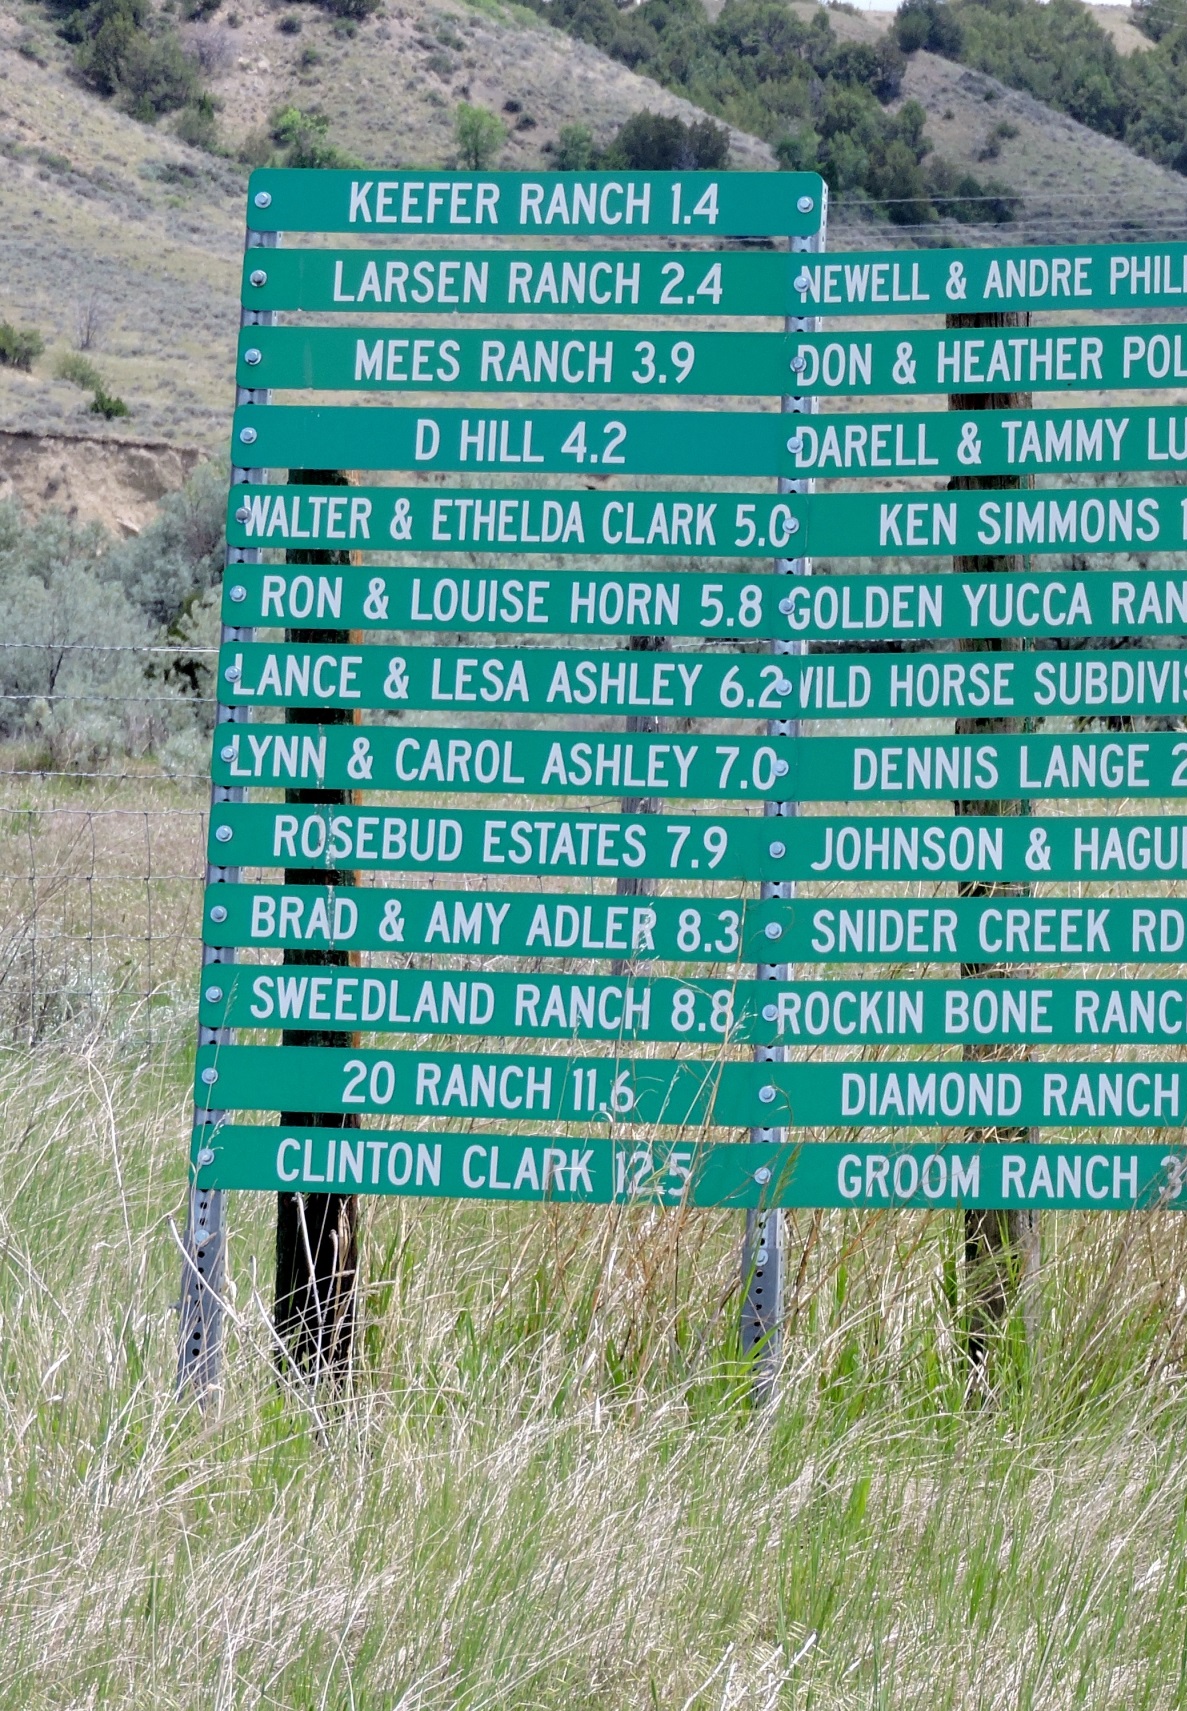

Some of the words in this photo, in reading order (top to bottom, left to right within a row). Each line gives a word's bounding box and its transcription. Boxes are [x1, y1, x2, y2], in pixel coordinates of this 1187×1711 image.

[350, 182, 499, 223] KEEFER
[520, 183, 650, 224] RANCH
[672, 183, 718, 224] 1.4
[334, 261, 488, 303] LARSEN
[509, 262, 640, 304] RANCH
[661, 262, 722, 304] 2.4
[800, 263, 929, 303] NEWELL
[946, 261, 966, 300] &
[984, 258, 1092, 298] ANDRE
[355, 340, 460, 381] MEES
[481, 341, 612, 383] RANCH
[632, 341, 694, 383] 3.9
[797, 343, 871, 386] DON
[893, 342, 916, 384] &
[938, 338, 1103, 382] HEATHER
[416, 419, 439, 460] D
[460, 420, 544, 462] HILL
[562, 421, 626, 463] 4.2
[795, 424, 939, 467] DARELL
[957, 422, 981, 464] &
[1002, 419, 1129, 463] TAMMY
[244, 495, 371, 538] WALTER
[390, 501, 412, 540] &
[433, 499, 584, 542] ETHELDA
[603, 502, 716, 545] CLARK
[735, 504, 790, 547] 5.0
[880, 503, 956, 545] KEN
[978, 498, 1159, 544] SIMMONS
[262, 576, 342, 618] RON
[364, 578, 388, 619] &
[412, 579, 549, 622] LOUISE
[571, 582, 679, 625] HORN
[701, 585, 762, 627] 5.8
[787, 585, 942, 630] GOLDEN
[963, 583, 1092, 626] YUCCA
[232, 654, 362, 697] LANCE
[384, 657, 409, 699] &
[432, 659, 529, 701] LESA
[547, 661, 702, 705] ASHLEY
[720, 665, 784, 708] 6.2
[891, 663, 1014, 707] HORSE
[230, 735, 326, 778] LYNN
[348, 737, 373, 779] &
[396, 738, 524, 783] CAROL
[542, 743, 697, 787] ASHLEY
[716, 747, 776, 790] 7.0
[854, 746, 998, 790] DENNIS
[1020, 744, 1149, 787] LANGE
[274, 815, 462, 861] ROSEBUD
[484, 821, 646, 867] ESTATES
[667, 826, 727, 868] 7.9
[811, 827, 1002, 870] JOHNSON
[1025, 828, 1050, 870] &
[251, 895, 357, 941] BRAD
[379, 900, 404, 941] &
[425, 902, 510, 944] AMY
[526, 906, 656, 950] ADLER
[677, 909, 740, 955] 8.3
[812, 910, 957, 952] SNIDER
[979, 909, 1110, 952] CREEK
[1133, 910, 1184, 952] RD
[251, 976, 494, 1025] SWEEDLAND
[516, 984, 650, 1029] RANCH
[672, 988, 735, 1033] 8.8
[777, 991, 923, 1036] ROCKIN
[945, 990, 1052, 1033] BONE
[342, 1060, 395, 1104] 20
[416, 1063, 551, 1109] RANCH
[574, 1069, 635, 1112] 11.6
[842, 1073, 1021, 1116] DIAMOND
[1044, 1073, 1178, 1117] RANCH
[277, 1138, 441, 1186] CLINTON
[463, 1145, 593, 1191] CLARK
[838, 1154, 979, 1198] GROOM
[1002, 1155, 1137, 1198] RANCH
